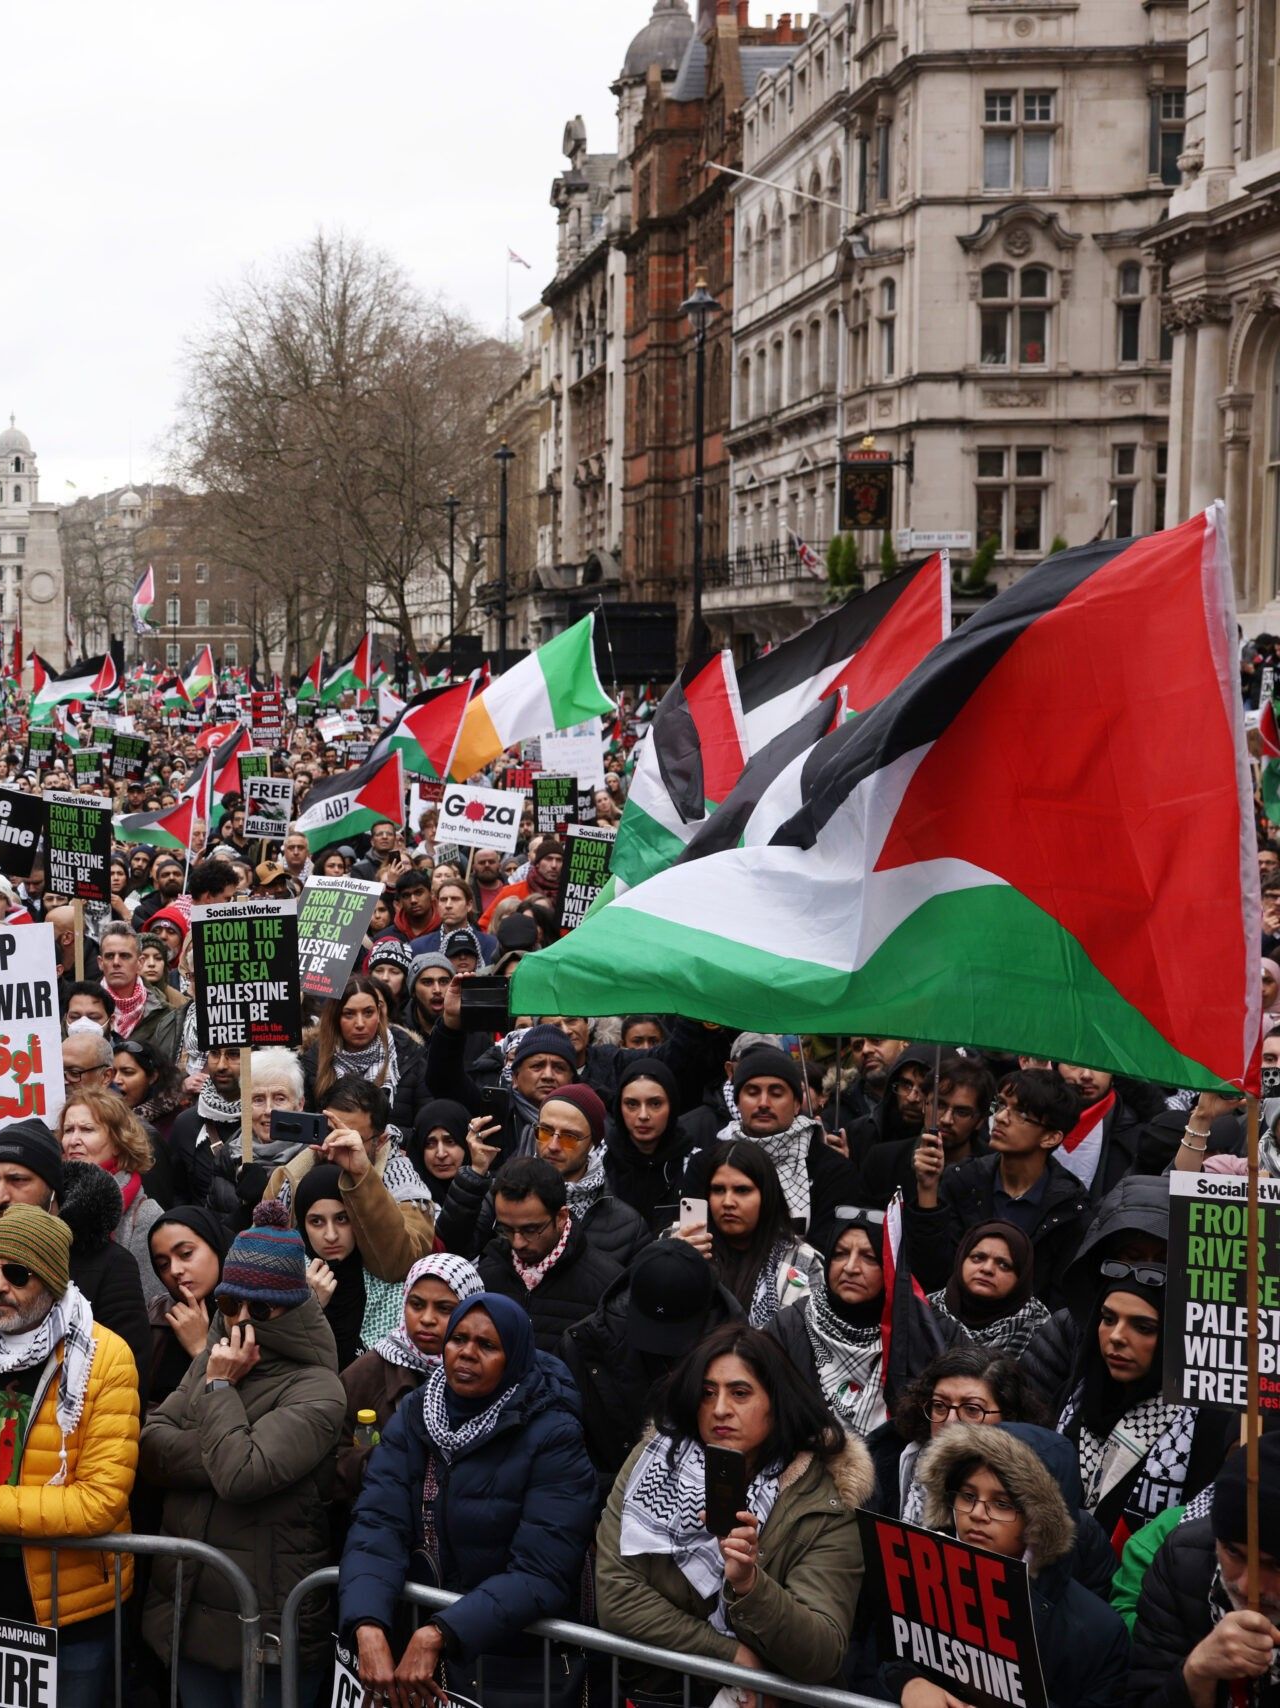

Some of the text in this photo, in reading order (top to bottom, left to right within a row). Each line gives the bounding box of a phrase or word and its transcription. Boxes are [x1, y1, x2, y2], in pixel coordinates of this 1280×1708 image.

[250, 783, 291, 799] FREE
[537, 778, 571, 788] FROM THE
[538, 788, 568, 797] RIVER TO
[538, 797, 566, 806] THE SEA
[538, 805, 574, 815] PALESTINE
[49, 804, 101, 825] FROM THE
[538, 814, 565, 823] WILL BE
[50, 820, 96, 838] RIVER TO
[246, 821, 287, 832] PALESTINE
[440, 822, 512, 839] Stop the massacre
[538, 823, 555, 832] FREE
[50, 834, 91, 853] THE SEA
[573, 839, 607, 855] FROM
[50, 848, 104, 869] PALESTINE
[570, 854, 605, 870] RIVER
[50, 863, 90, 882] WILL BE
[569, 869, 593, 884] THE
[51, 878, 74, 895] FREE
[306, 889, 368, 911] FROM THE
[300, 905, 354, 926] RIVER TO
[203, 919, 283, 943] FROM THE
[297, 921, 342, 942] THE SEA
[204, 940, 275, 964] RIVER TO
[205, 961, 270, 984] THE SEA
[308, 956, 329, 973] BE
[206, 981, 289, 1004] PALESTINE
[206, 1002, 269, 1025] WILL BE
[208, 1024, 246, 1045] FREE
[251, 1023, 282, 1032] Back the
[251, 1033, 289, 1042] resistance
[1186, 1269, 1237, 1303] THE
[1183, 1335, 1248, 1371] WILL
[1182, 1369, 1248, 1406] FREE
[875, 1520, 1018, 1661] FREE
[892, 1615, 1027, 1708] PALESTINE
